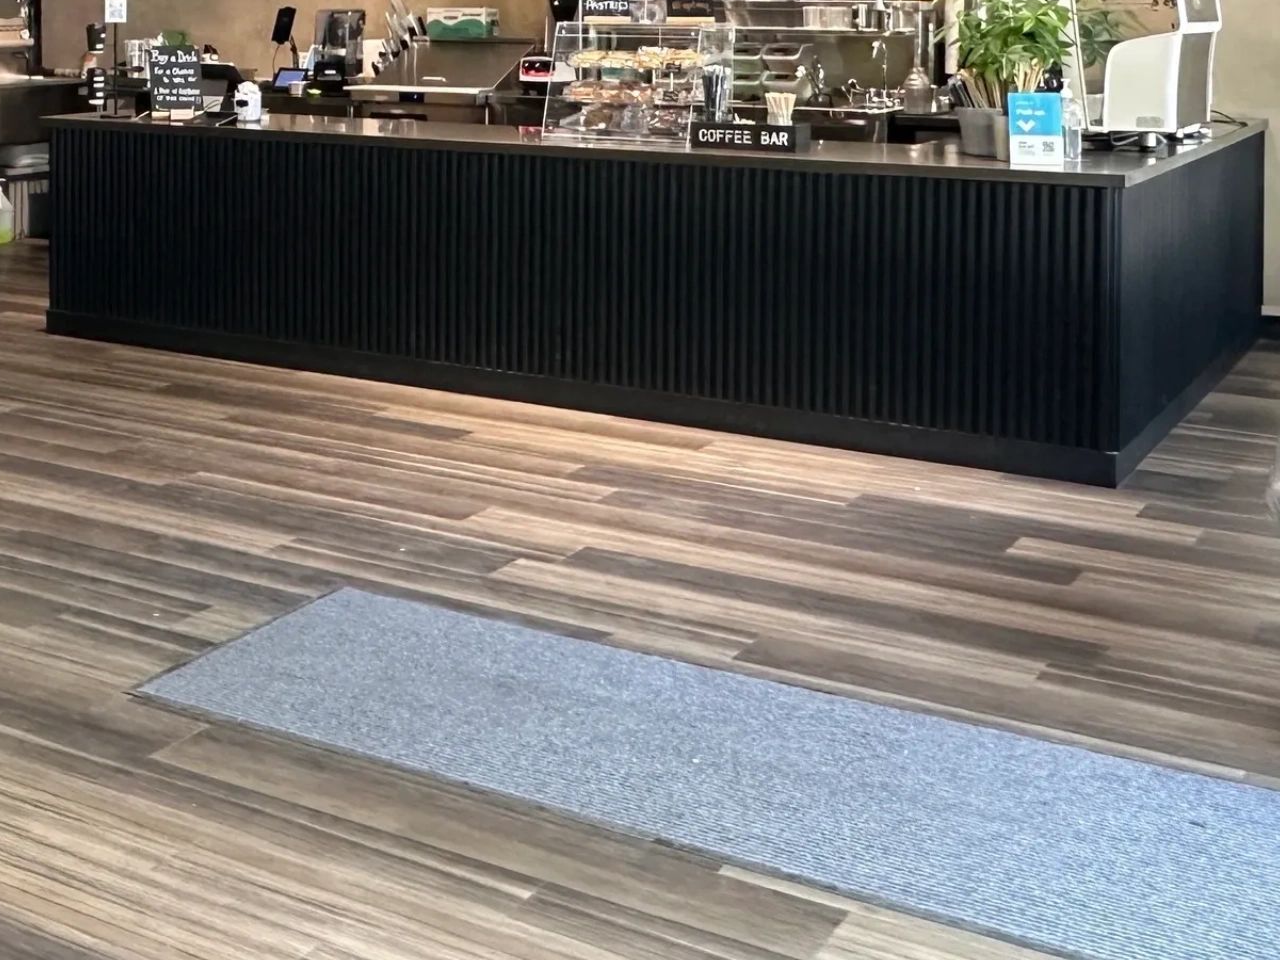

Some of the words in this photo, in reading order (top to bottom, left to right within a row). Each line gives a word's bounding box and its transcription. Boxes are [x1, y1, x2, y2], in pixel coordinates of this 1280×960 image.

[150, 50, 169, 65] Buy
[177, 50, 198, 63] Drink
[698, 129, 752, 144] COFFEE
[760, 130, 788, 146] BAR
